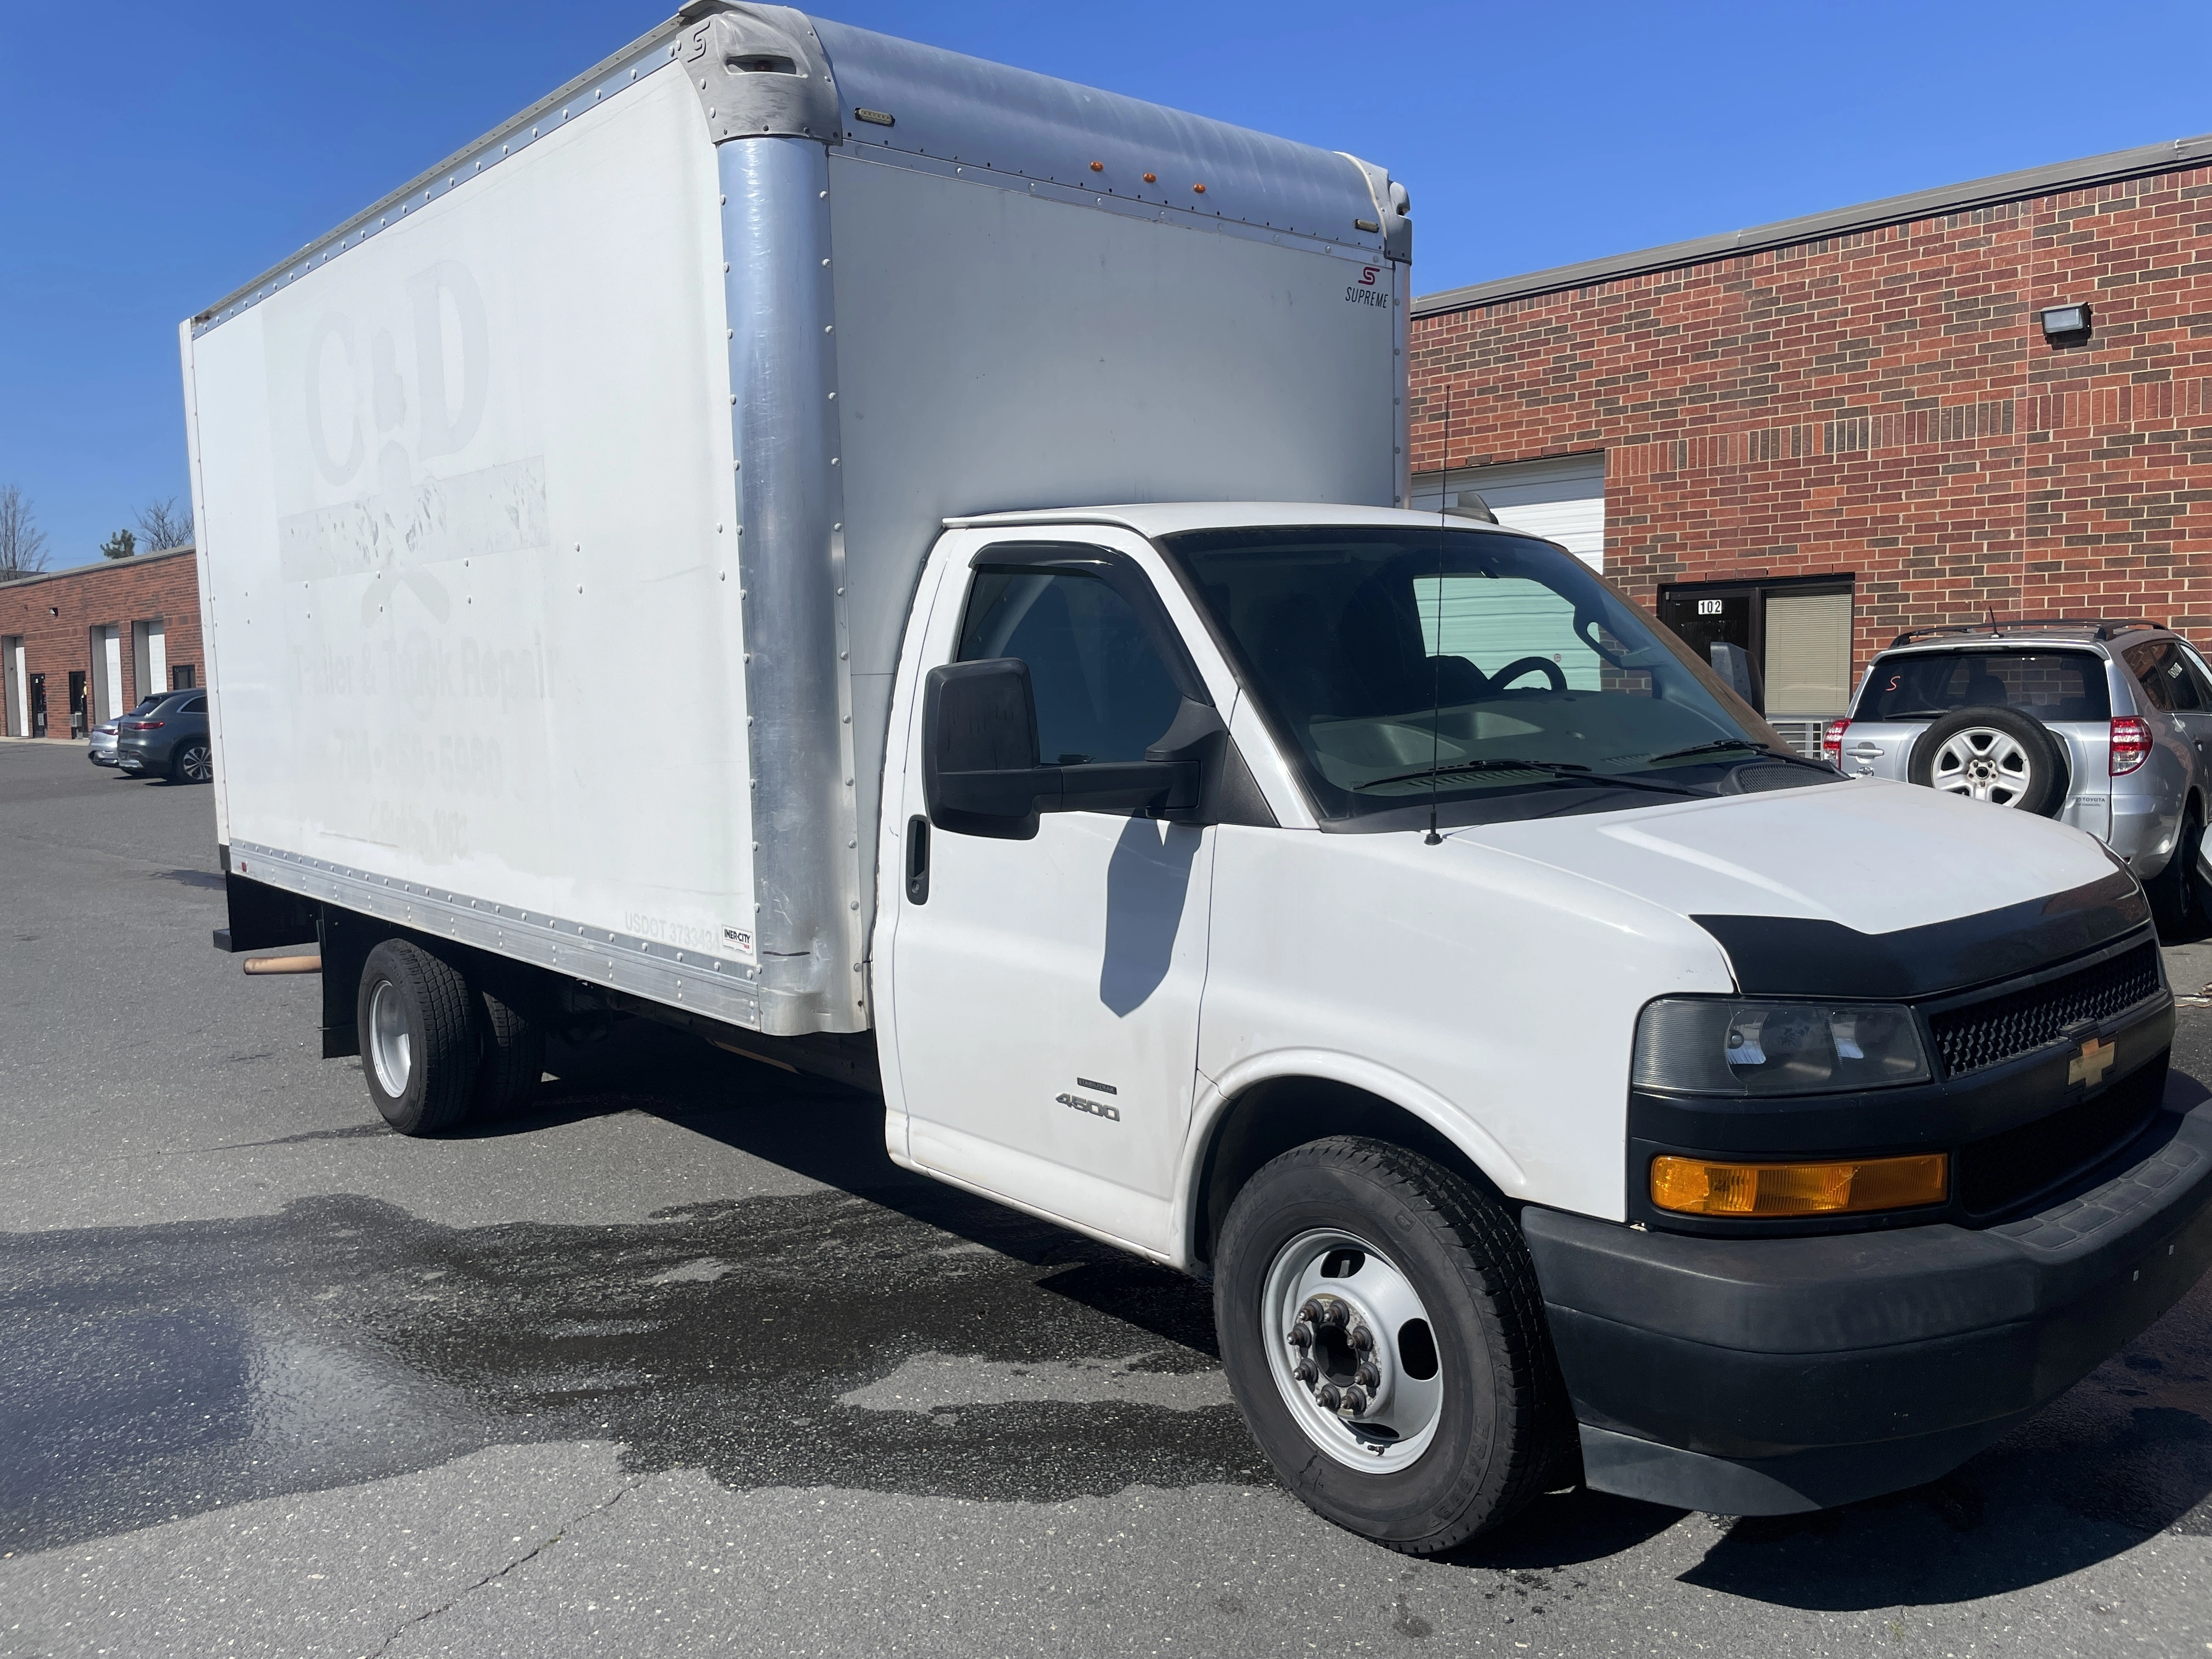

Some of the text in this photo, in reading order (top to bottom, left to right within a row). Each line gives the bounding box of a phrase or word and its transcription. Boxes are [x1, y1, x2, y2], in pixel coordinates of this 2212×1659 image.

[1345, 287, 1389, 308] SUPREME
[1701, 601, 1720, 613] 102
[1886, 675, 1900, 691] S
[625, 911, 667, 940] USDOT
[1055, 1093, 1120, 1122] 4500
